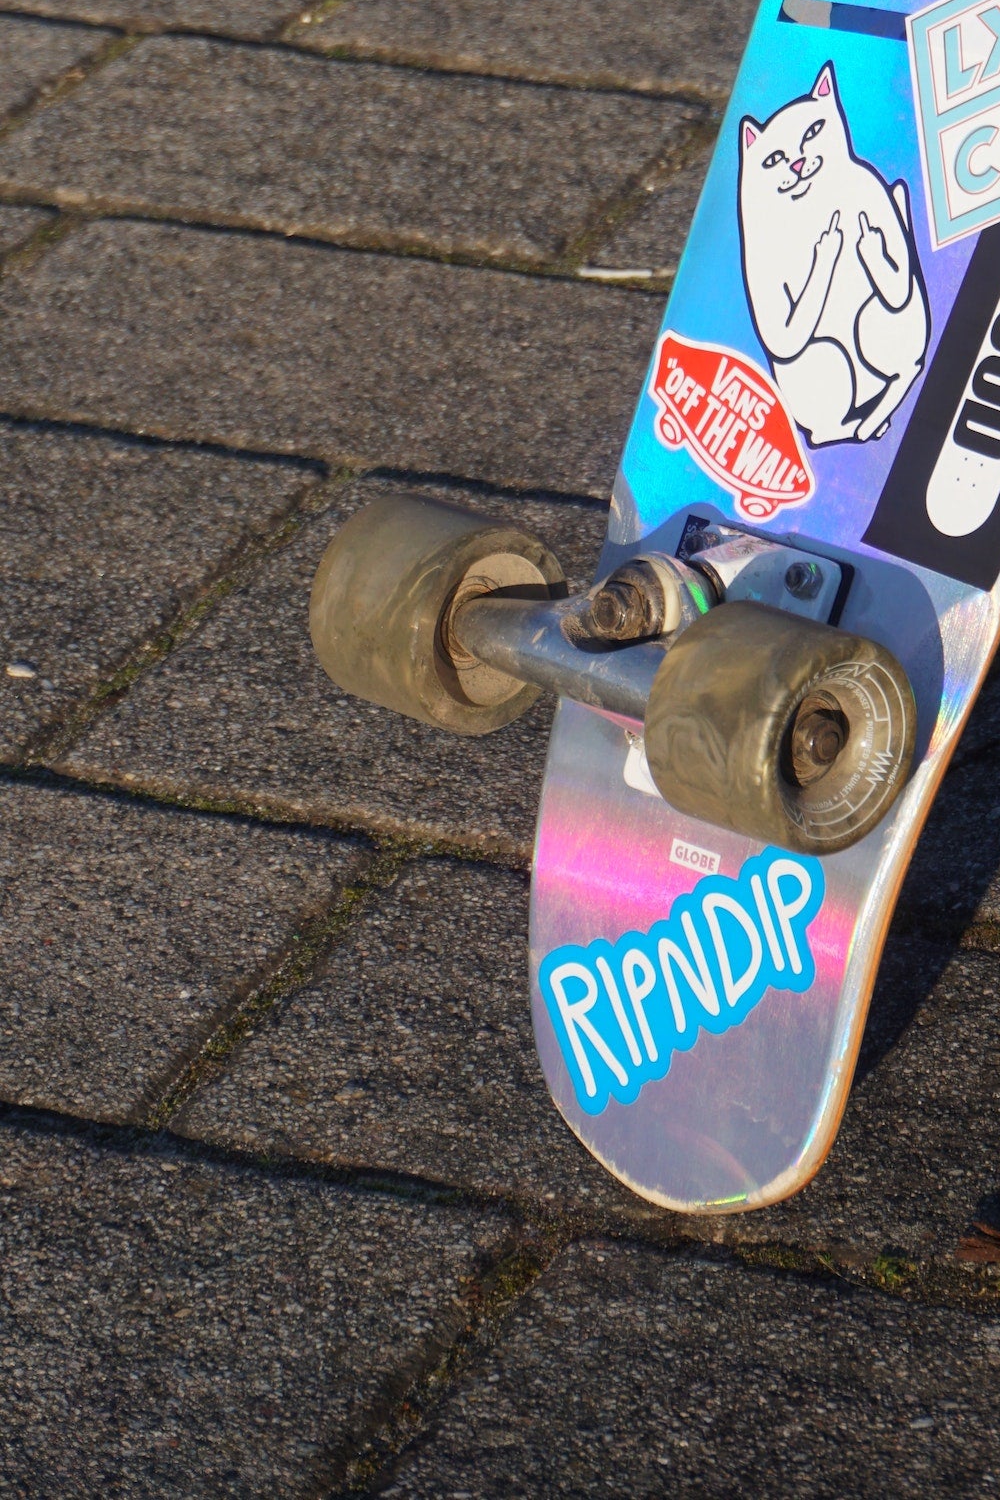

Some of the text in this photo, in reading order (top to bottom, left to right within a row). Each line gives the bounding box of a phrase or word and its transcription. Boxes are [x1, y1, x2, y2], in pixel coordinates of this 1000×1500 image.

[711, 357, 776, 431] VANS
[694, 395, 747, 467] THE
[862, 721, 874, 759] POWERED
[840, 772, 861, 798] SUNSET
[674, 844, 716, 871] GLOBE
[551, 859, 812, 1097] RIPNDIP
